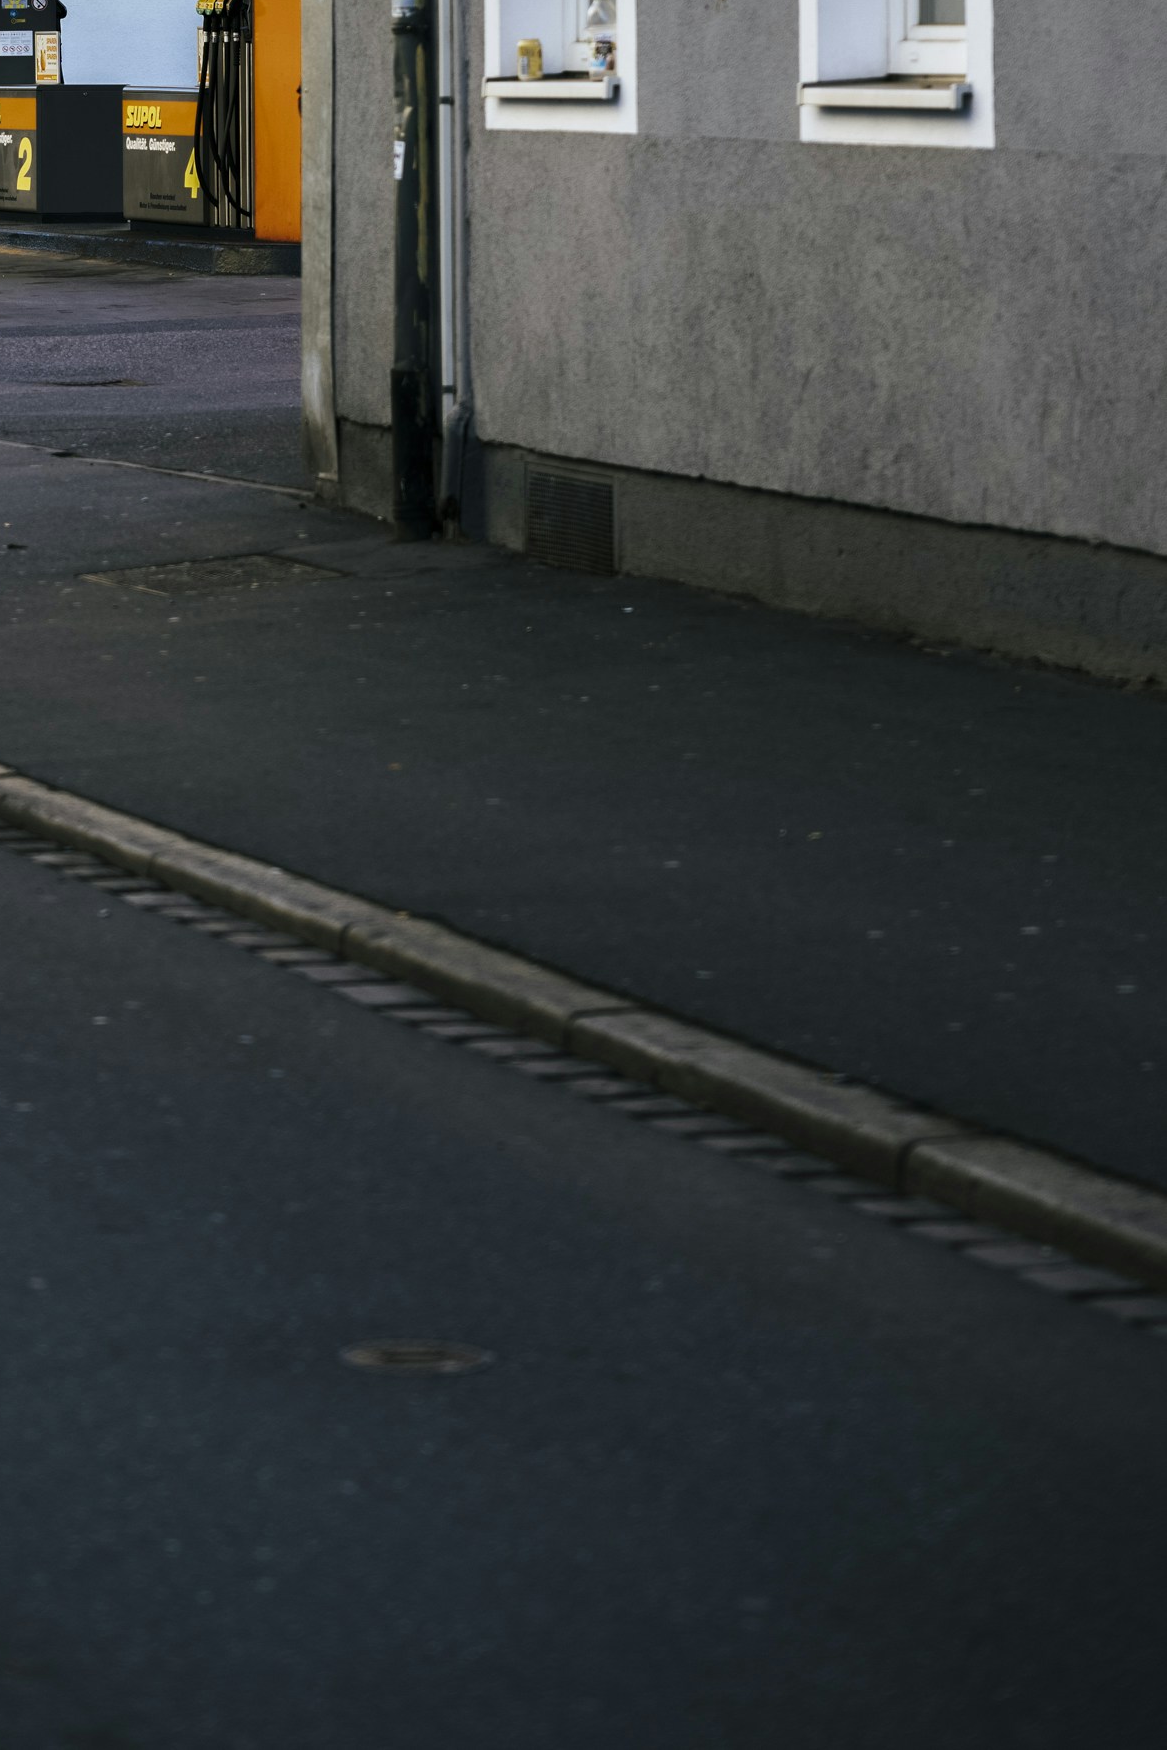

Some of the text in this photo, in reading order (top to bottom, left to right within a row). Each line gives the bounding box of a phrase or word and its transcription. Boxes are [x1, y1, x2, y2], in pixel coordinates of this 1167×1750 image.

[126, 105, 162, 129] SUPOL
[16, 137, 33, 191] 2
[126, 136, 176, 154] Qualität. Günstiger.
[184, 146, 200, 199] 4
